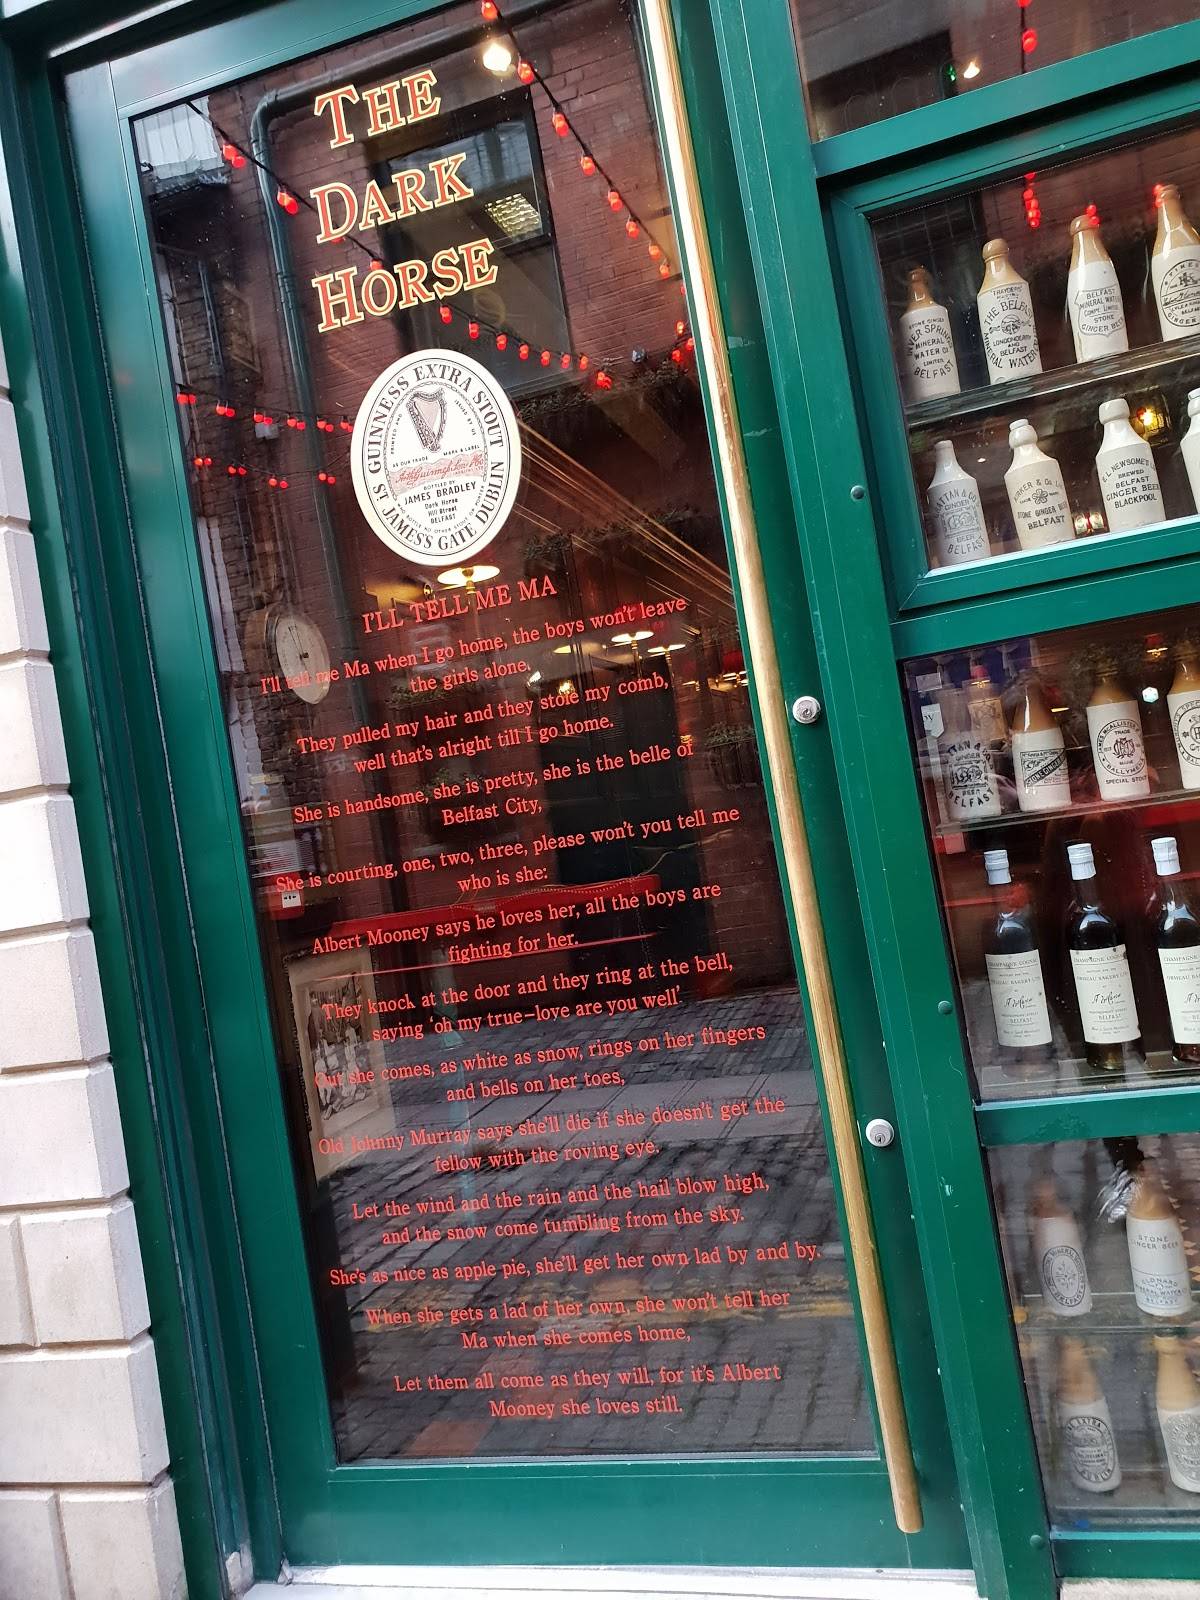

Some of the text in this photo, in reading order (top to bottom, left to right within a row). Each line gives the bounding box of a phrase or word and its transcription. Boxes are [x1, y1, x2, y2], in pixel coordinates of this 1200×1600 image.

[313, 69, 441, 149] THE
[310, 152, 474, 243] DARK
[311, 238, 499, 333] HORSE
[1086, 288, 1115, 299] BELFAST
[1080, 298, 1104, 310] MINERAL
[984, 307, 999, 326] THE
[1094, 314, 1114, 323] STONE
[1082, 323, 1109, 332] GINGER
[916, 338, 944, 349] MINERAL
[984, 332, 1003, 368] MINERAL
[1000, 346, 1028, 356] BELFAST
[914, 348, 940, 360] WATER
[914, 360, 954, 379] BELFAST
[368, 364, 504, 474] GUINNESS EXTRA STOUT
[465, 444, 480, 452] LABEL
[1115, 476, 1149, 489] BELFAST
[1118, 469, 1144, 479] BREWED
[404, 481, 477, 505] JAMES BRADLEY
[423, 481, 447, 490] BOTTLED
[1106, 486, 1138, 501] GINGER
[425, 501, 438, 510] Dark
[438, 523, 477, 550] GATE
[475, 461, 504, 524] DUBLIN
[439, 505, 457, 514] Street
[945, 500, 970, 511] GINGER
[1114, 493, 1158, 509] BLACKPOOL
[430, 513, 456, 524] BELFAST
[1035, 505, 1056, 517] GINGER
[1027, 515, 1065, 530] BELFAST
[947, 535, 985, 555] BELFAST
[956, 534, 975, 543] BEER
[362, 577, 557, 633] I'LL TELL ME MA
[260, 601, 687, 693] I'll tell me Ma when I go home, the boys won't leave
[297, 674, 670, 753] They pulled my hair and they stole my comb,
[294, 740, 694, 822] She is handsome, she is pretty, she is the belle of
[947, 787, 995, 808] BELFAST
[442, 799, 543, 825] Belfast City,
[458, 866, 548, 890] who is she:
[447, 934, 579, 962] fighting for her.
[322, 956, 734, 1019] They knock at the door and they ring at the bell,
[434, 1144, 660, 1171] fellow with the roving eye.
[382, 1207, 745, 1243] and the snow come tumbling from the sky.
[1138, 1234, 1168, 1243] STONE
[394, 1365, 781, 1390] Let them all come as they will, for it's Albert
[490, 1398, 683, 1418] Mooney she loves still.
